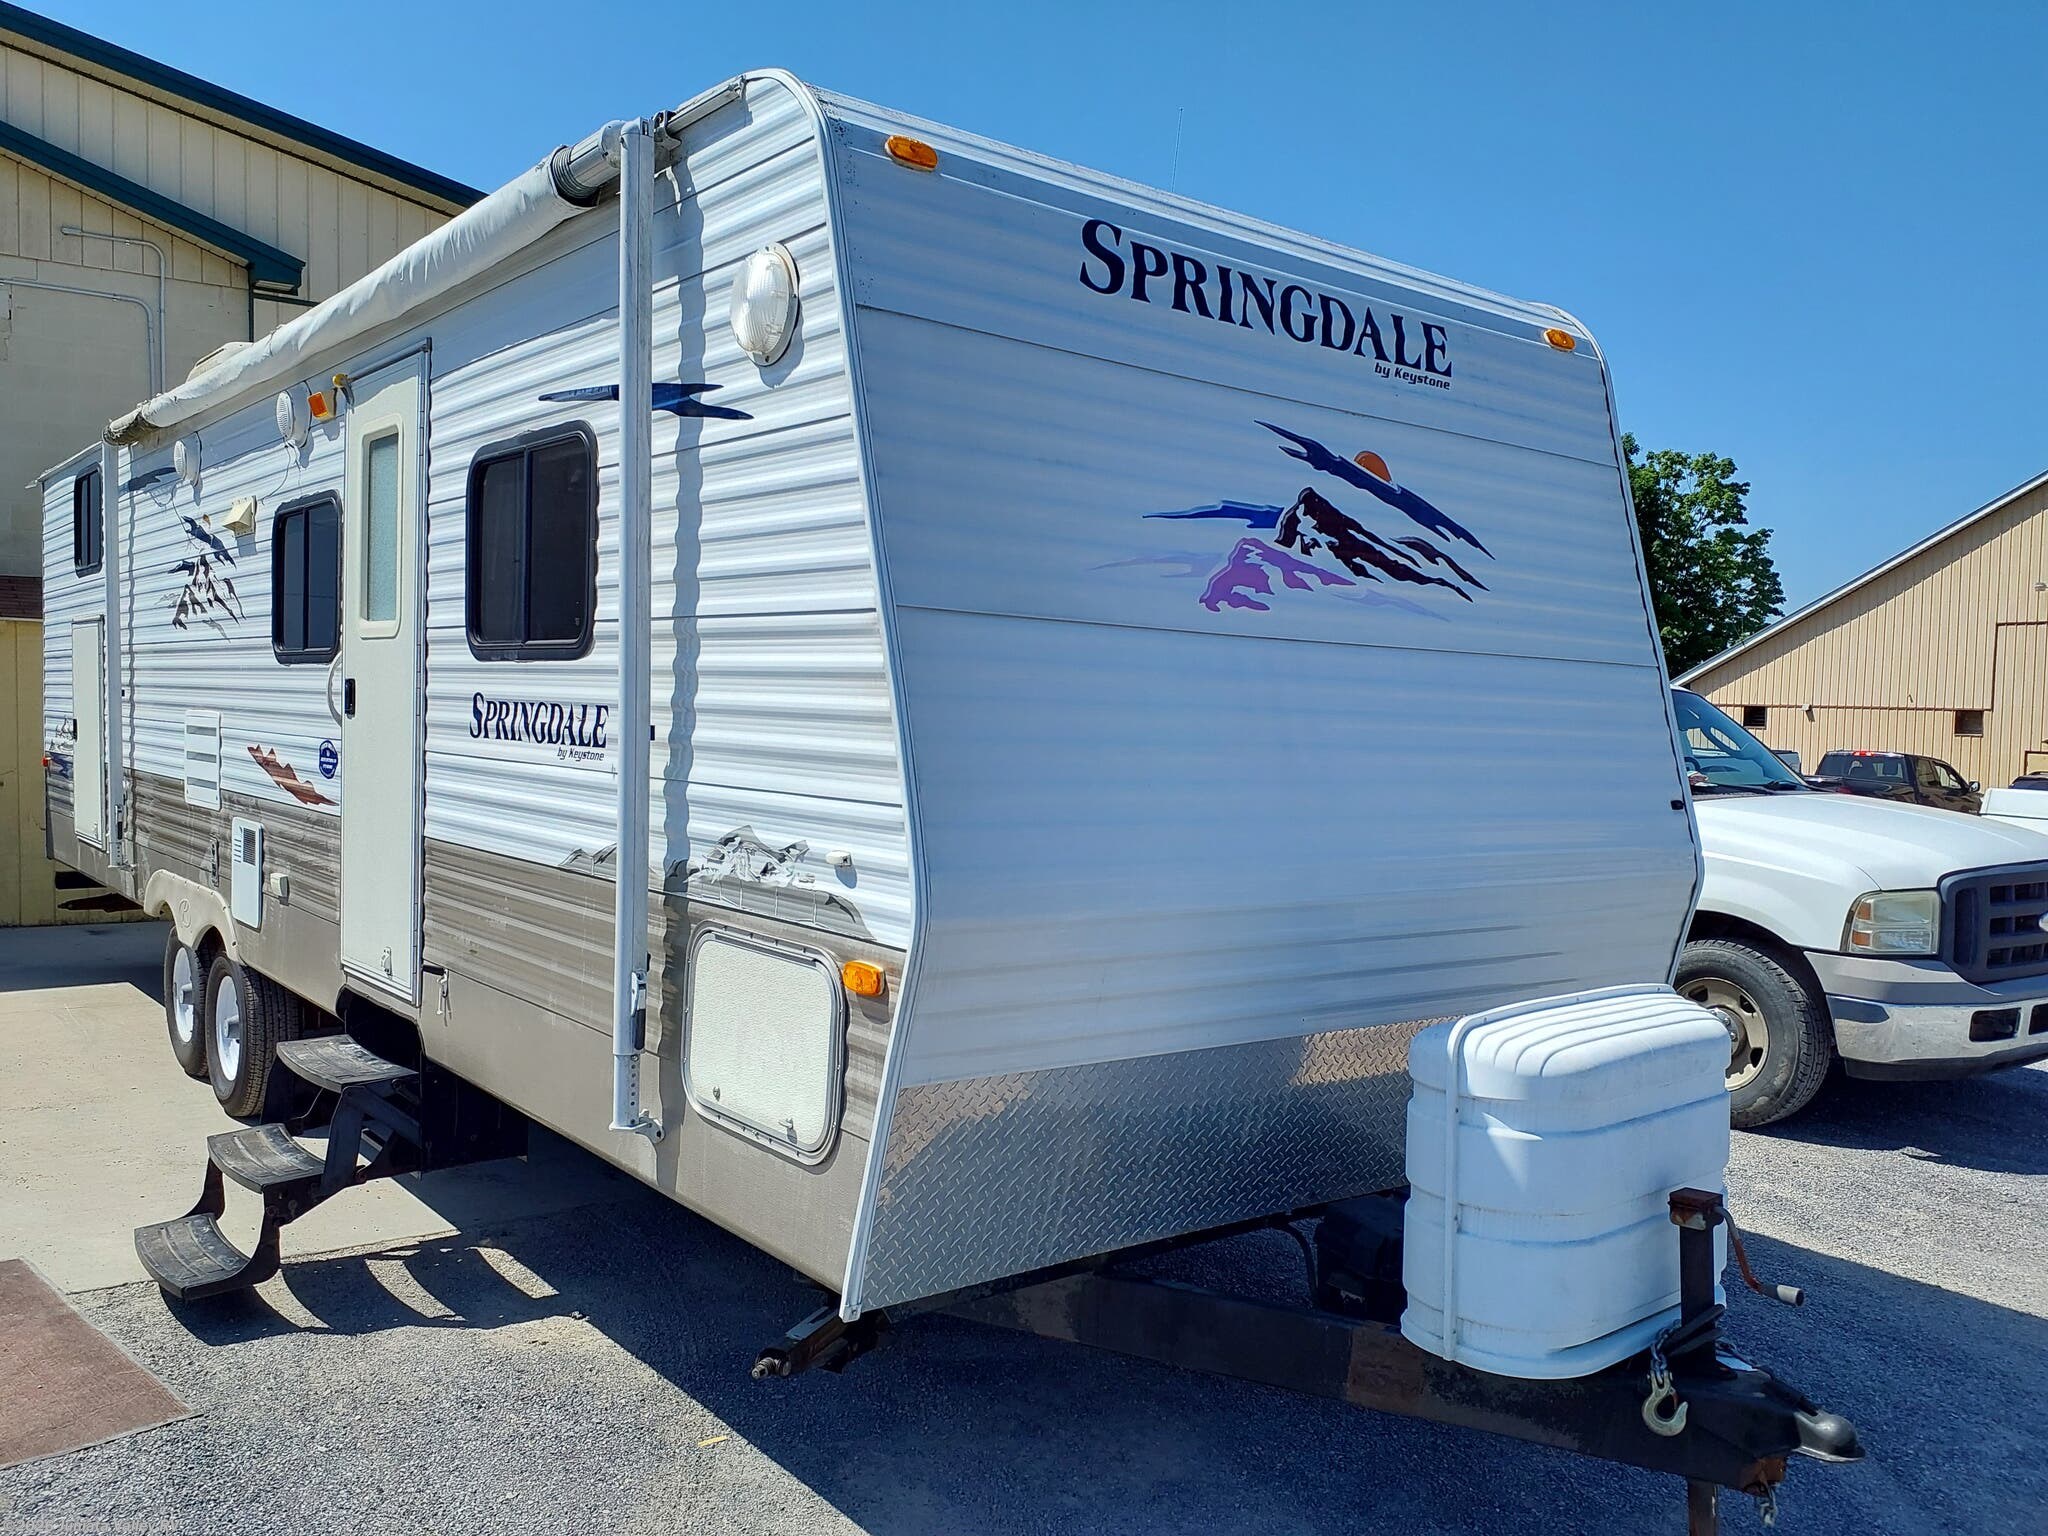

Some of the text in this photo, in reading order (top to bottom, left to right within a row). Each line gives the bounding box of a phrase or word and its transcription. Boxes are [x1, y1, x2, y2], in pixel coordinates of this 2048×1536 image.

[1079, 218, 1452, 378] SPRINGDALE
[1374, 362, 1451, 391] by Keystone
[469, 691, 609, 748] SPRINGDALE
[557, 746, 605, 762] by Keystone
